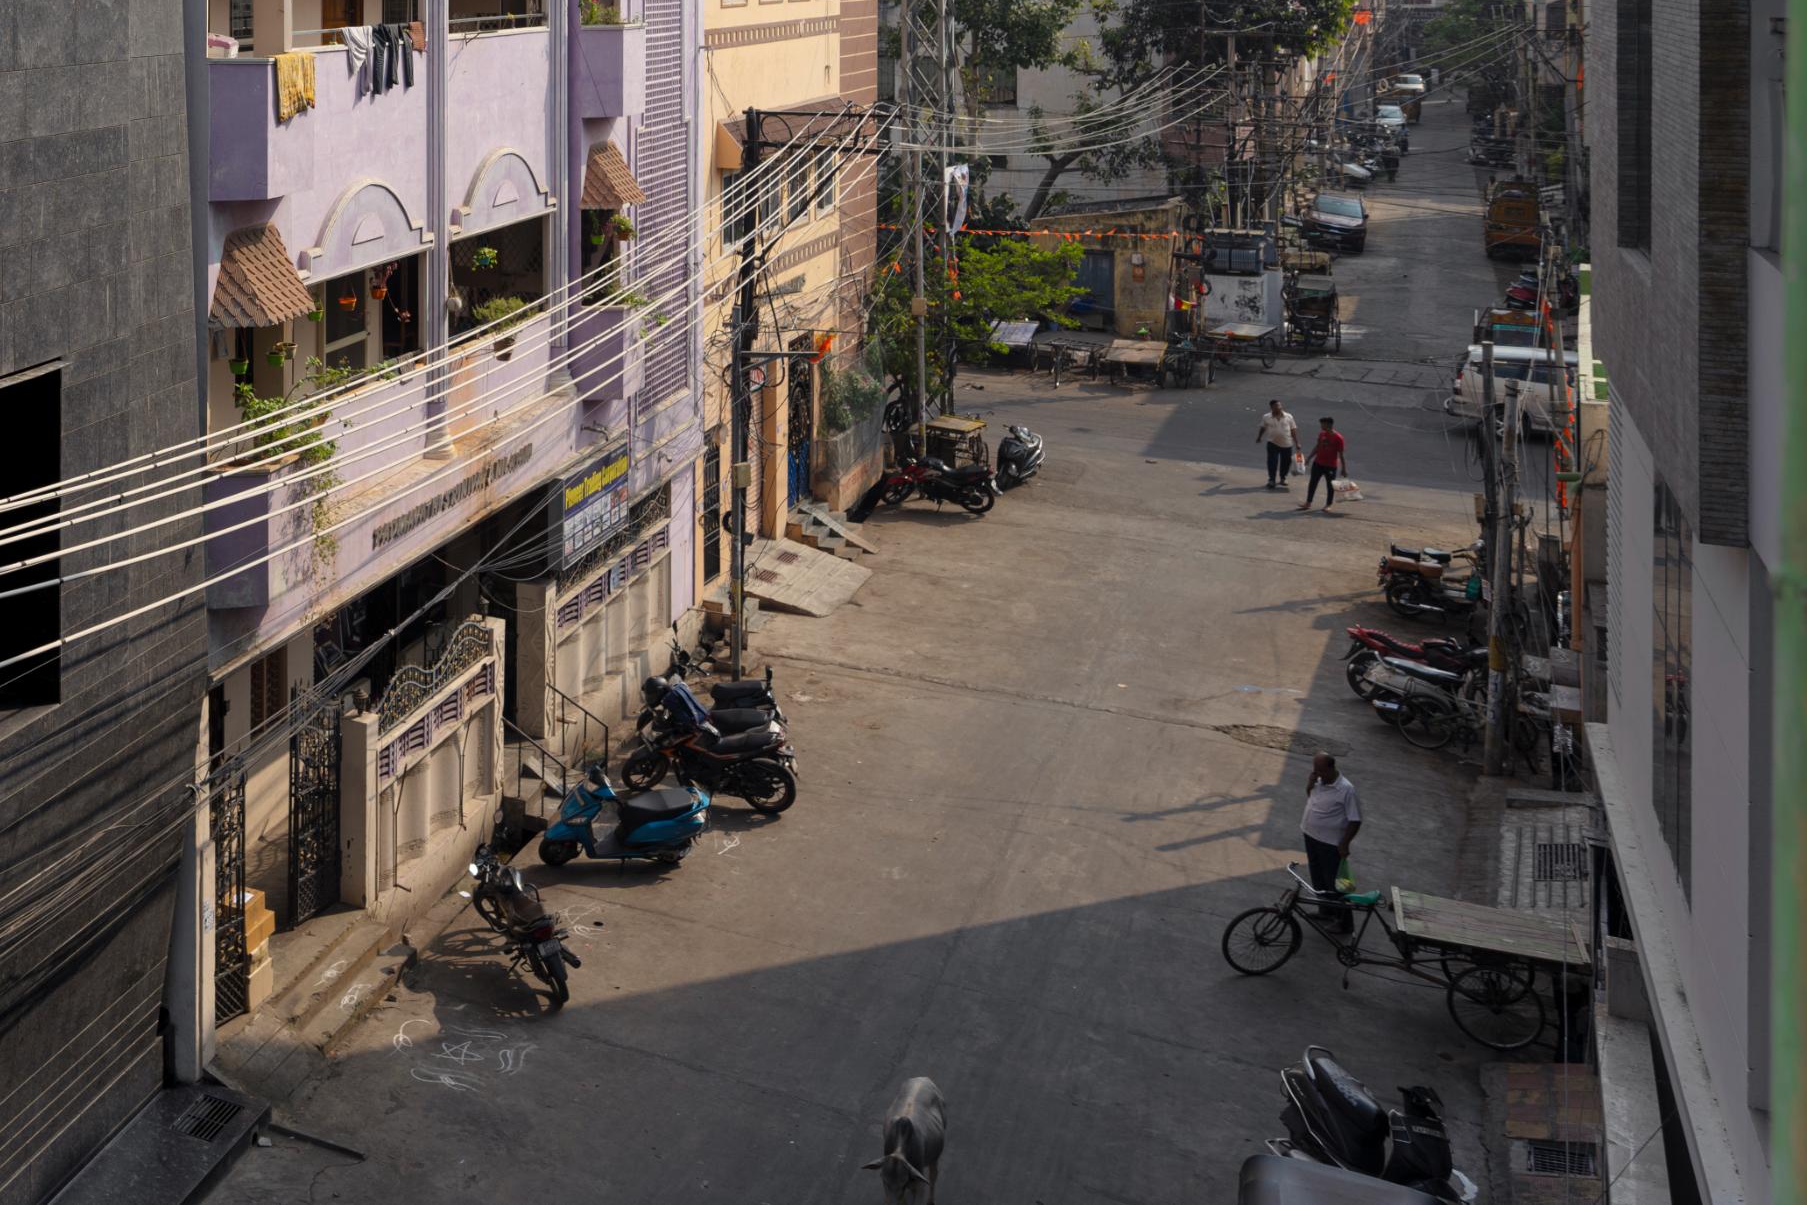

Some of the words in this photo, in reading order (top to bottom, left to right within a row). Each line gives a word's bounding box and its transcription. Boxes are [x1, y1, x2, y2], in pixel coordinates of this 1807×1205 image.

[565, 482, 584, 510] Pioneer
[584, 470, 602, 499] Trading
[602, 455, 628, 487] Corporation
